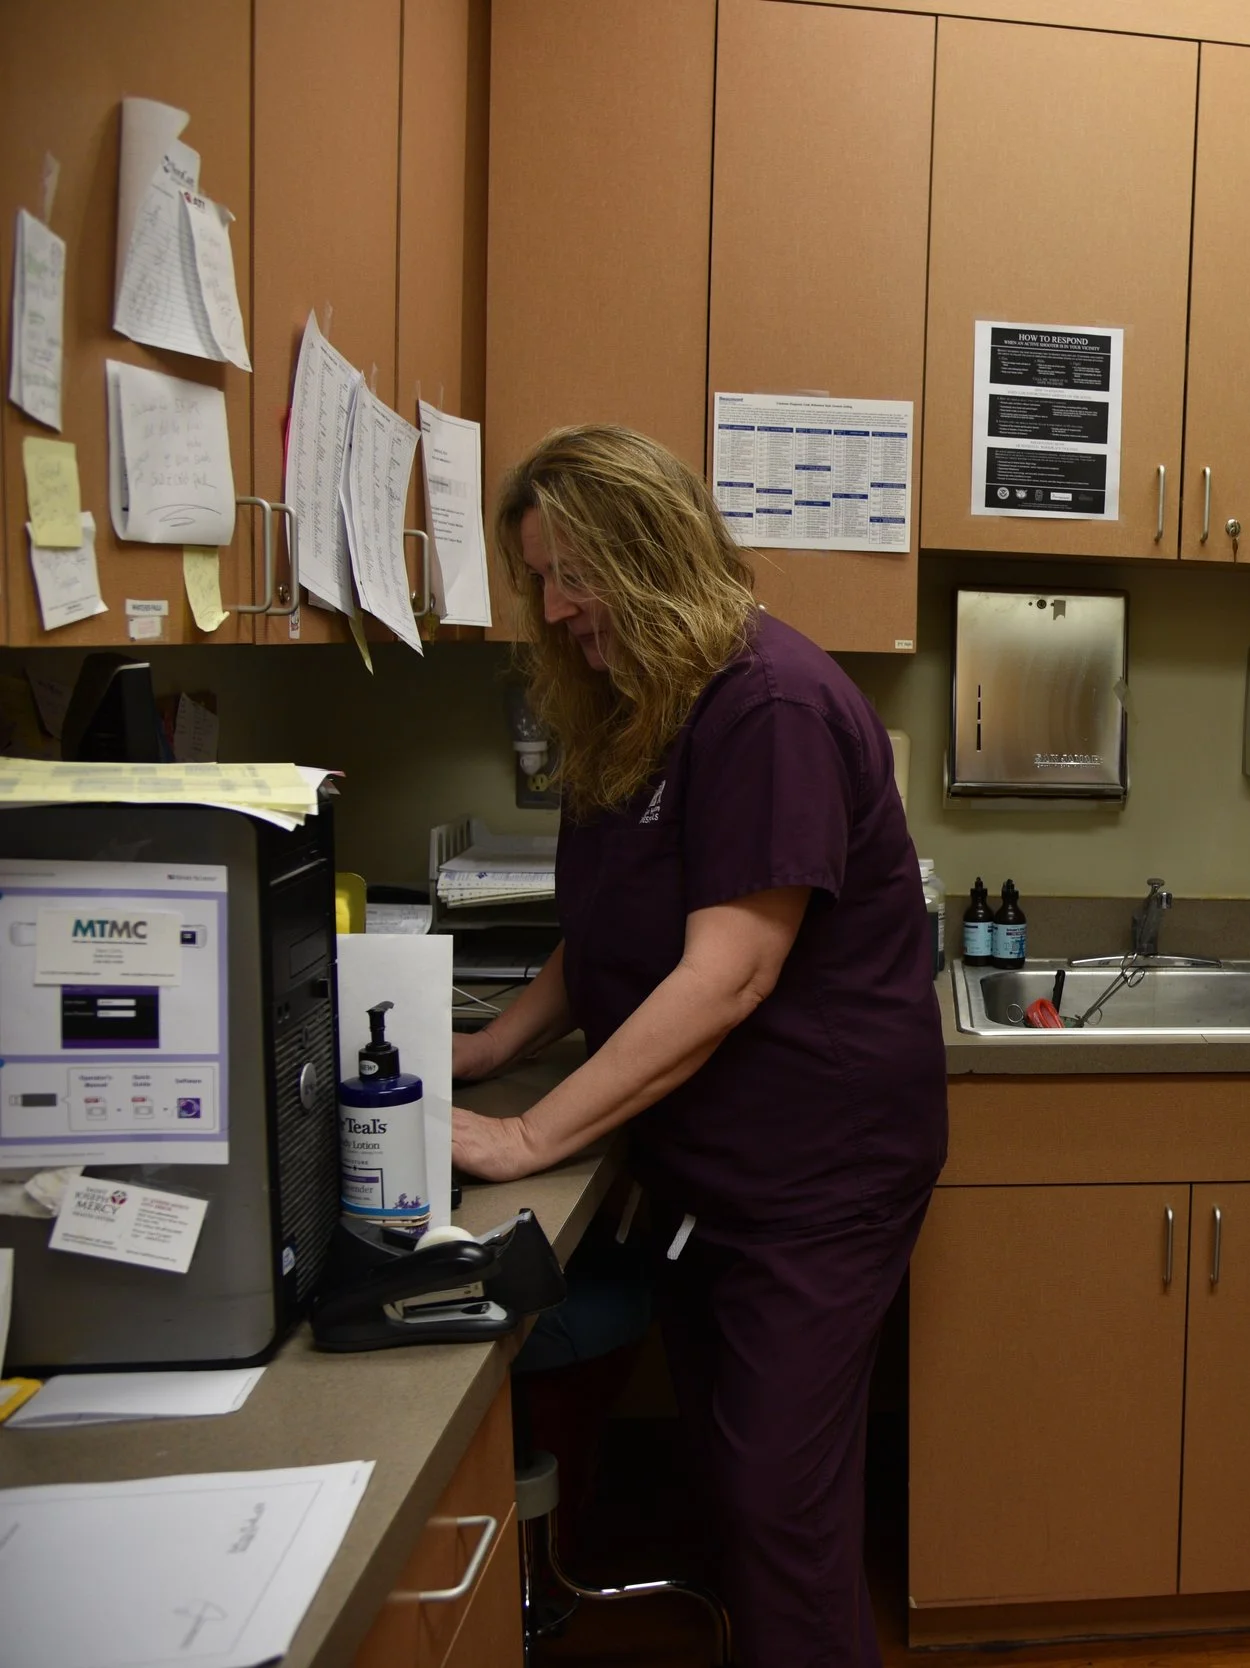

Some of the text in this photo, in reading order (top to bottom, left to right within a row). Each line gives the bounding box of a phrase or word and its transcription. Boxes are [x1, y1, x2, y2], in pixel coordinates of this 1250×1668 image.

[1018, 333, 1037, 342] HOW
[1052, 336, 1088, 346] RESPOND
[72, 919, 148, 939] MTMC
[346, 1118, 388, 1134] Teal's
[352, 1141, 380, 1150] Lotion
[76, 1200, 121, 1216] MERCY
